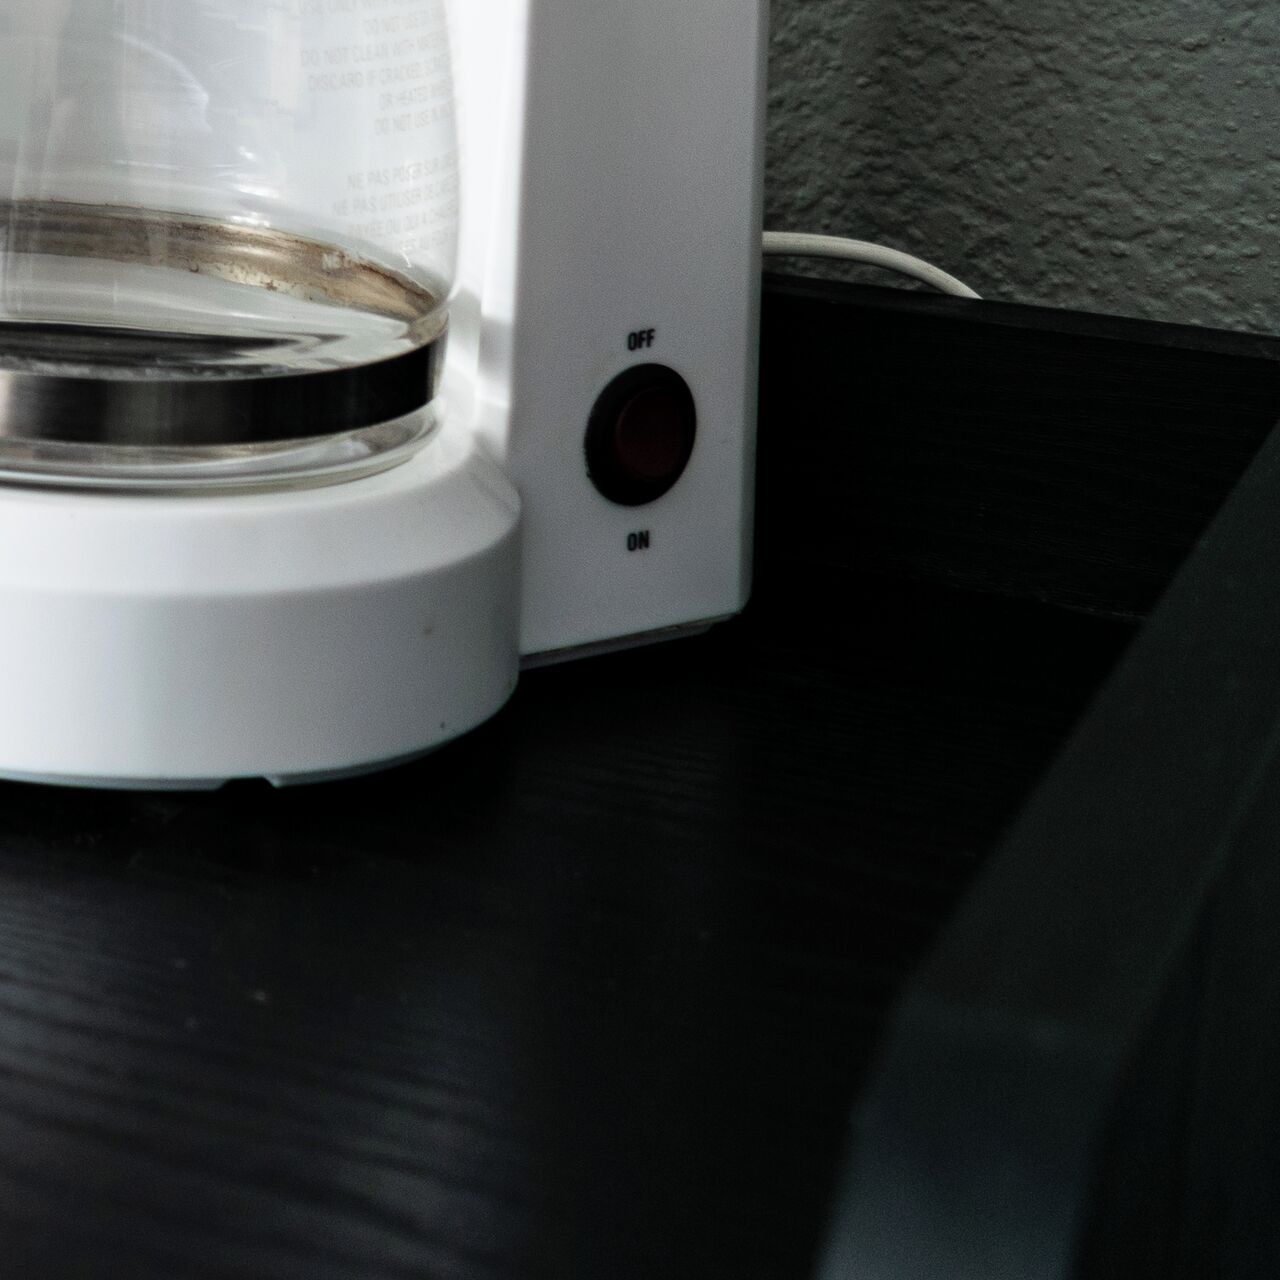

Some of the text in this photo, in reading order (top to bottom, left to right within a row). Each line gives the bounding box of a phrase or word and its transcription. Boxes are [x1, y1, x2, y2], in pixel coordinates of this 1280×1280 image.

[307, 70, 364, 92] DISCARD
[627, 328, 655, 351] OFF
[627, 530, 650, 552] ON
